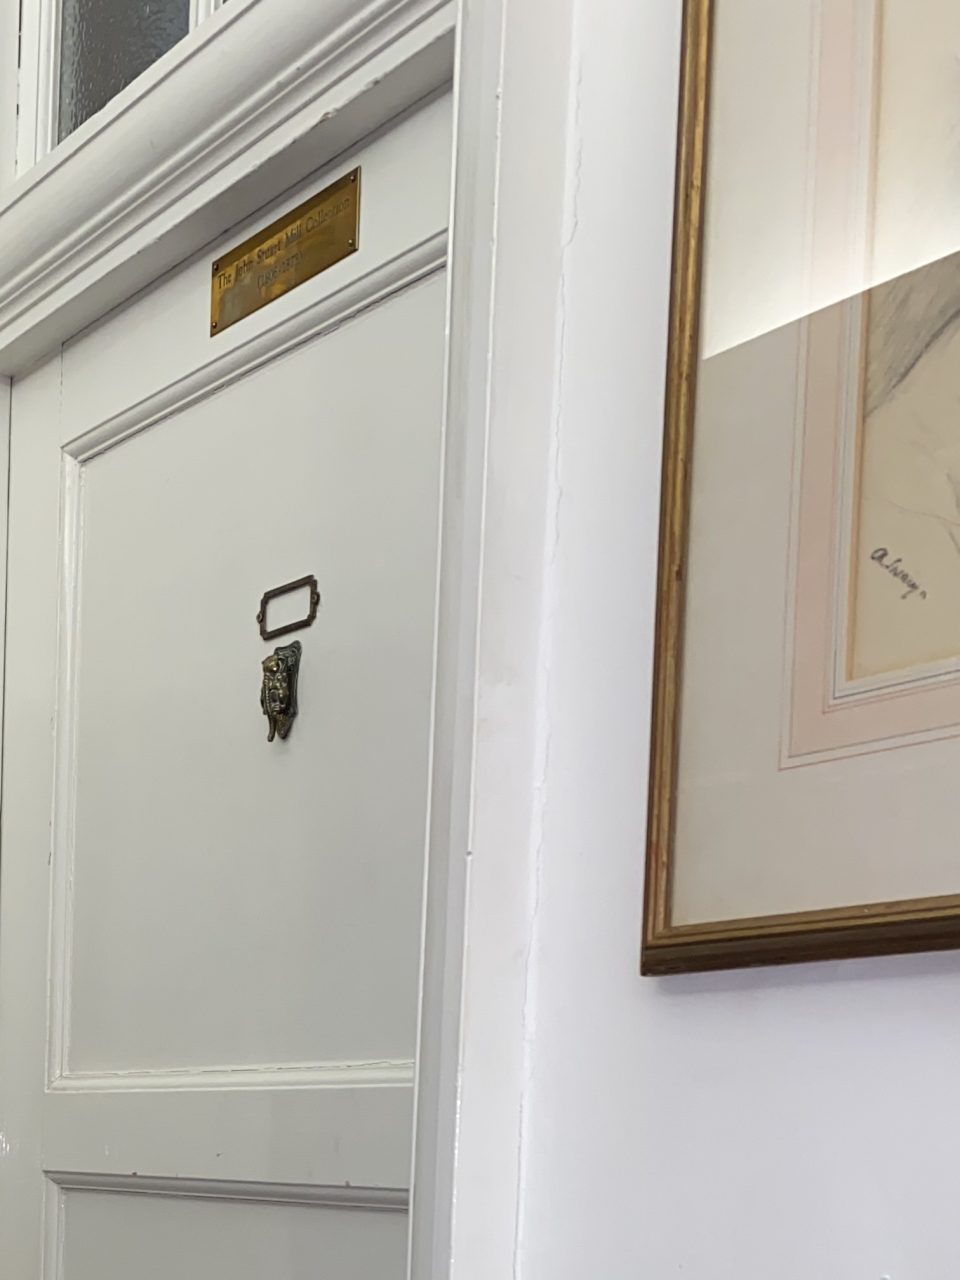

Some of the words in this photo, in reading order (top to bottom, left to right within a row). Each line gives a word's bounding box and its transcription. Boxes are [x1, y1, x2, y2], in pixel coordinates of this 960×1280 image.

[217, 271, 232, 289] The
[235, 258, 254, 282] John
[257, 241, 281, 262] Stuart
[284, 223, 302, 247] Mill
[305, 198, 350, 233] Collection
